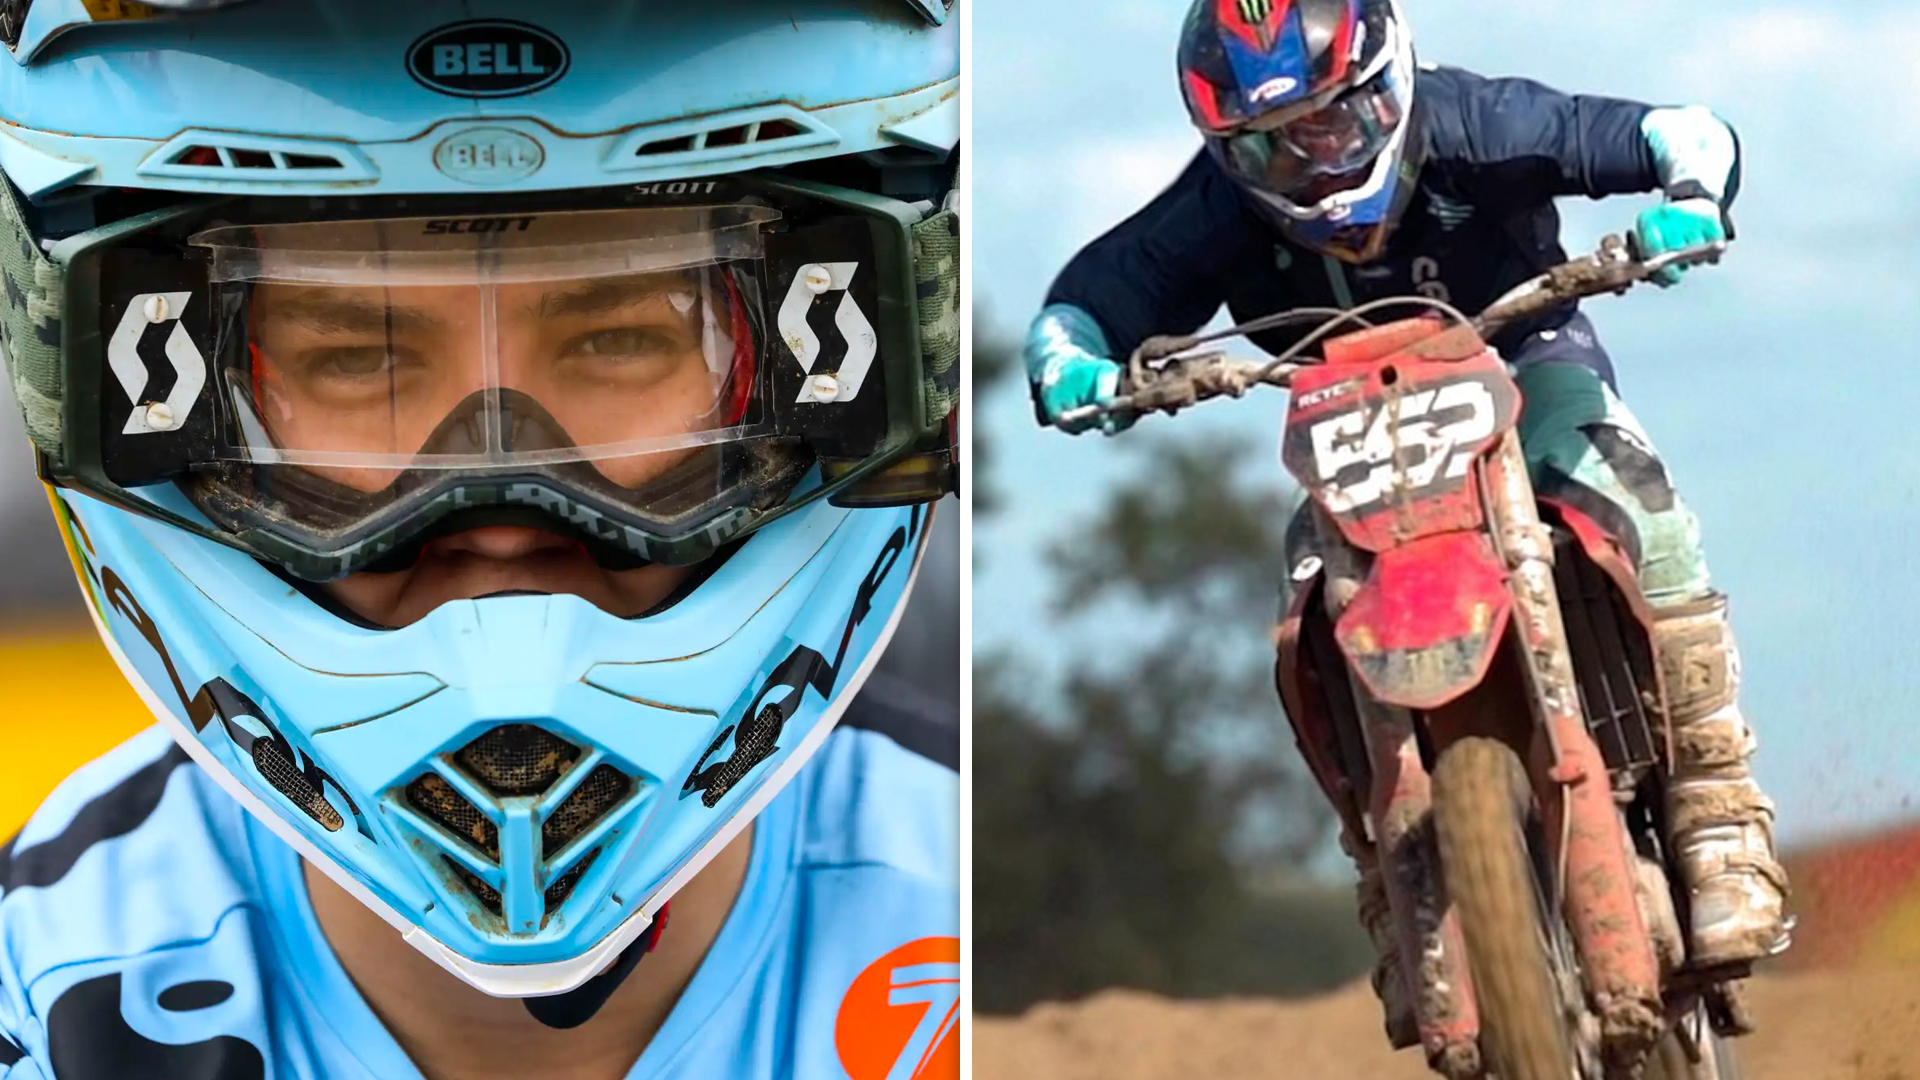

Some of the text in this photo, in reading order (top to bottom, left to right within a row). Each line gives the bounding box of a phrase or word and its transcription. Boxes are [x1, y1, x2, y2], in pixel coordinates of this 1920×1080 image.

[433, 43, 546, 76] BELL
[635, 181, 717, 195] SCOTT
[422, 216, 537, 234] SCOTT
